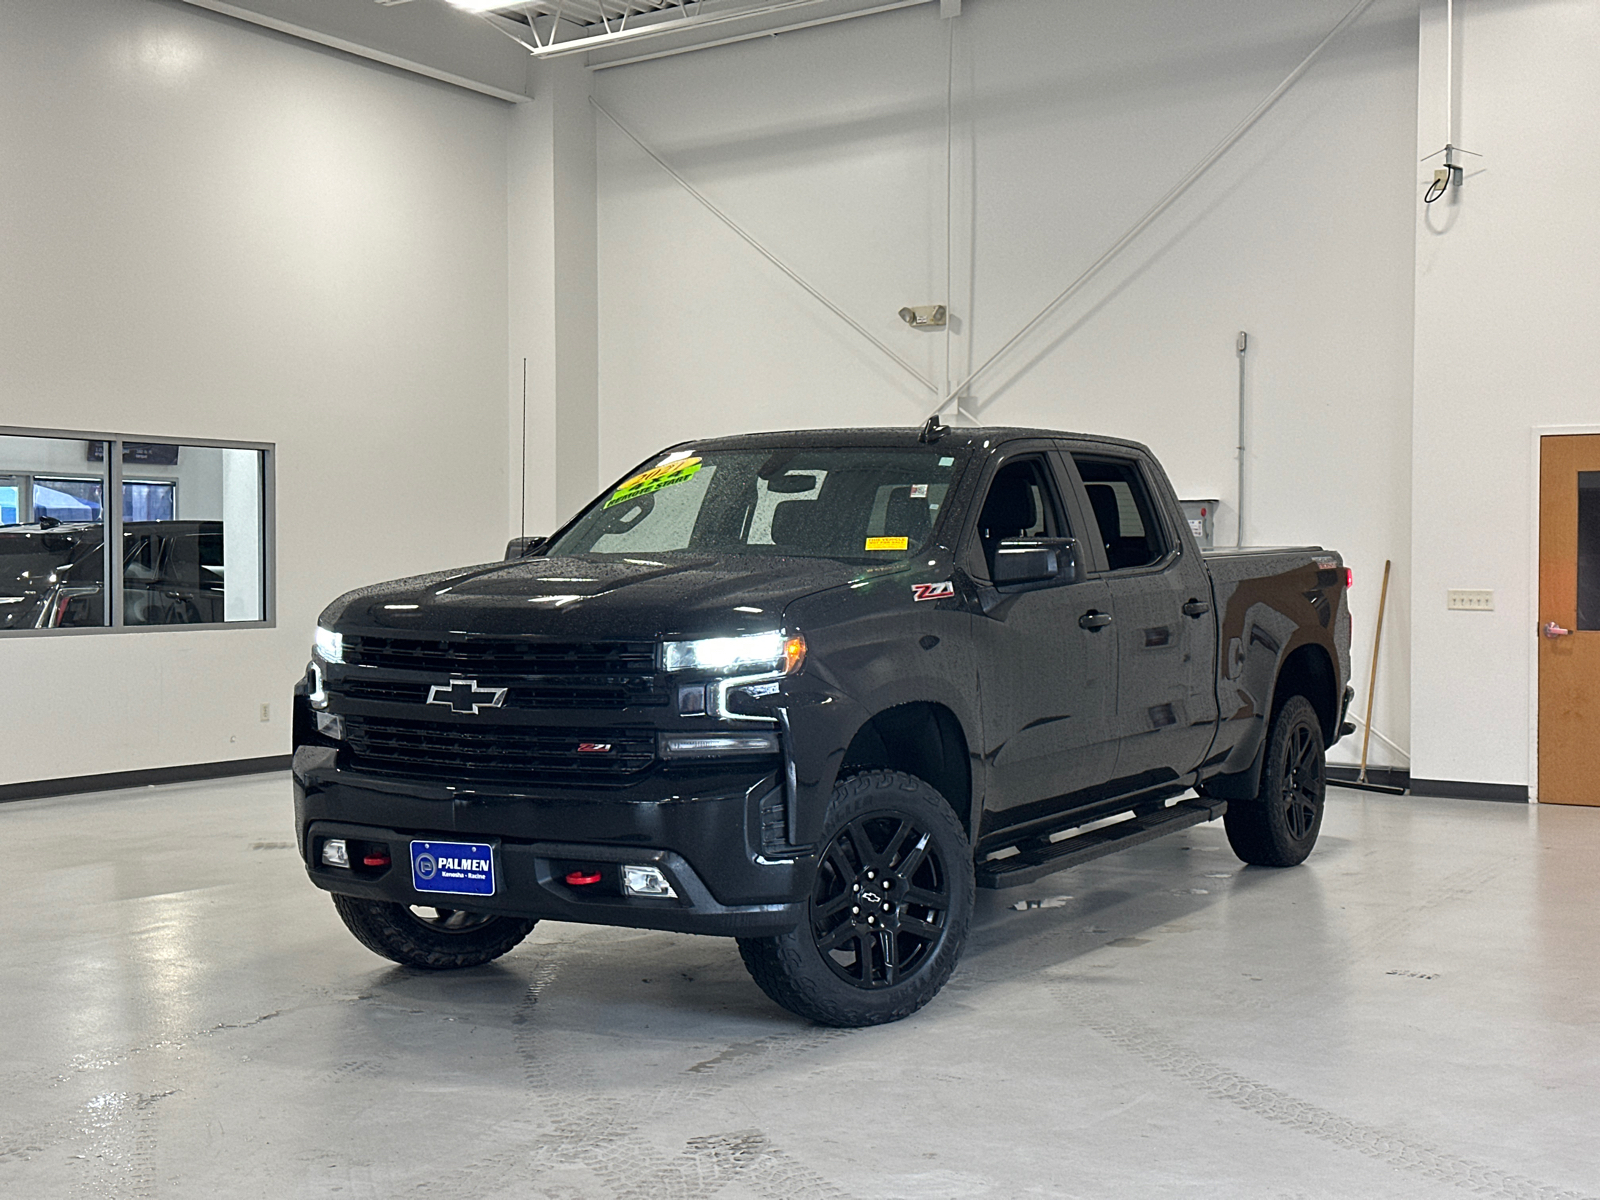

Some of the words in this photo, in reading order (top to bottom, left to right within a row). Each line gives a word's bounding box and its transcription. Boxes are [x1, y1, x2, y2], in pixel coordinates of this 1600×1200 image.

[607, 485, 654, 506] REMOTE
[654, 473, 692, 490] START
[577, 743, 611, 752] Z71
[438, 857, 489, 872] PALMEN
